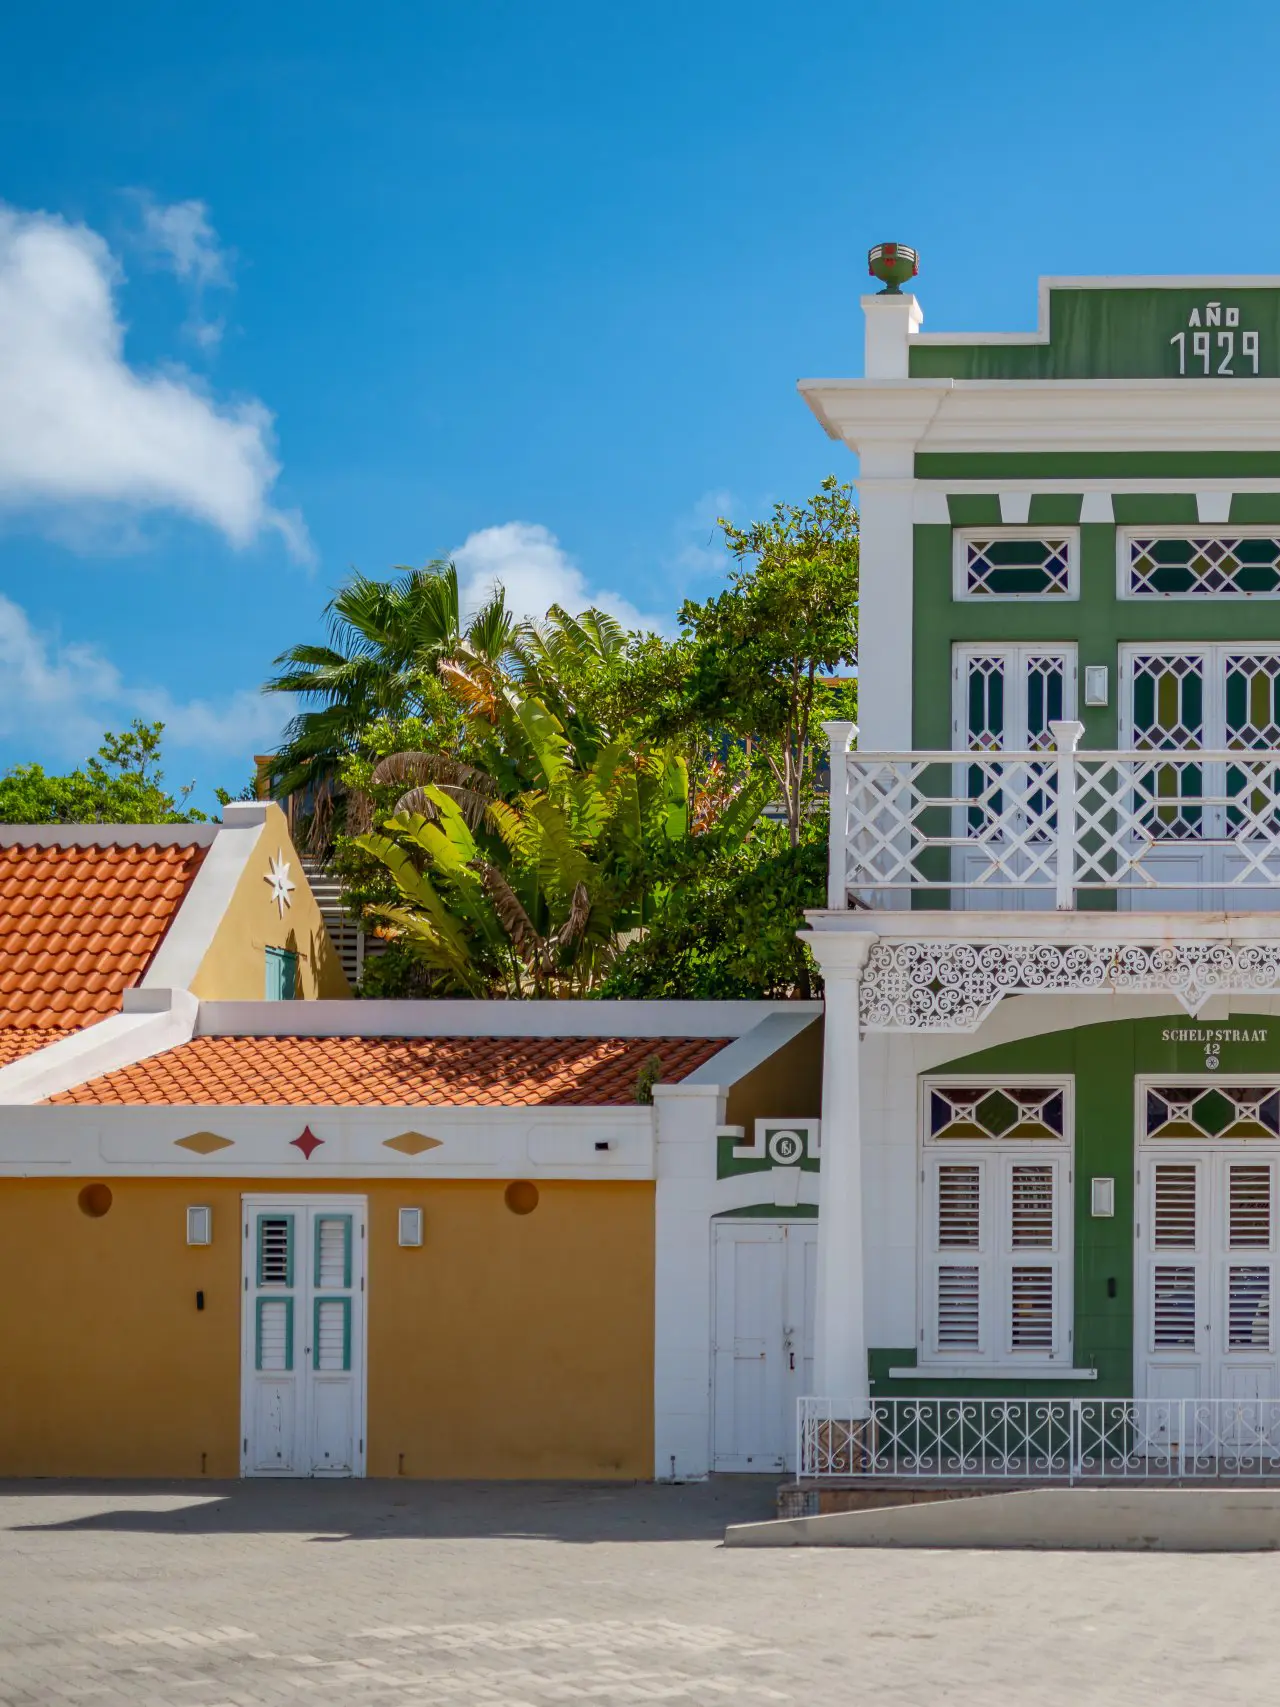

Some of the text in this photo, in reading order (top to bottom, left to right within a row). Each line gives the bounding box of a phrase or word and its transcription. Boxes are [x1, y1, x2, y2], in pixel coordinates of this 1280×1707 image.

[1188, 302, 1240, 328] AÑO
[1170, 331, 1259, 375] 1929
[1161, 1029, 1268, 1042] SCHELPSTRAAT
[1203, 1043, 1221, 1055] 42
